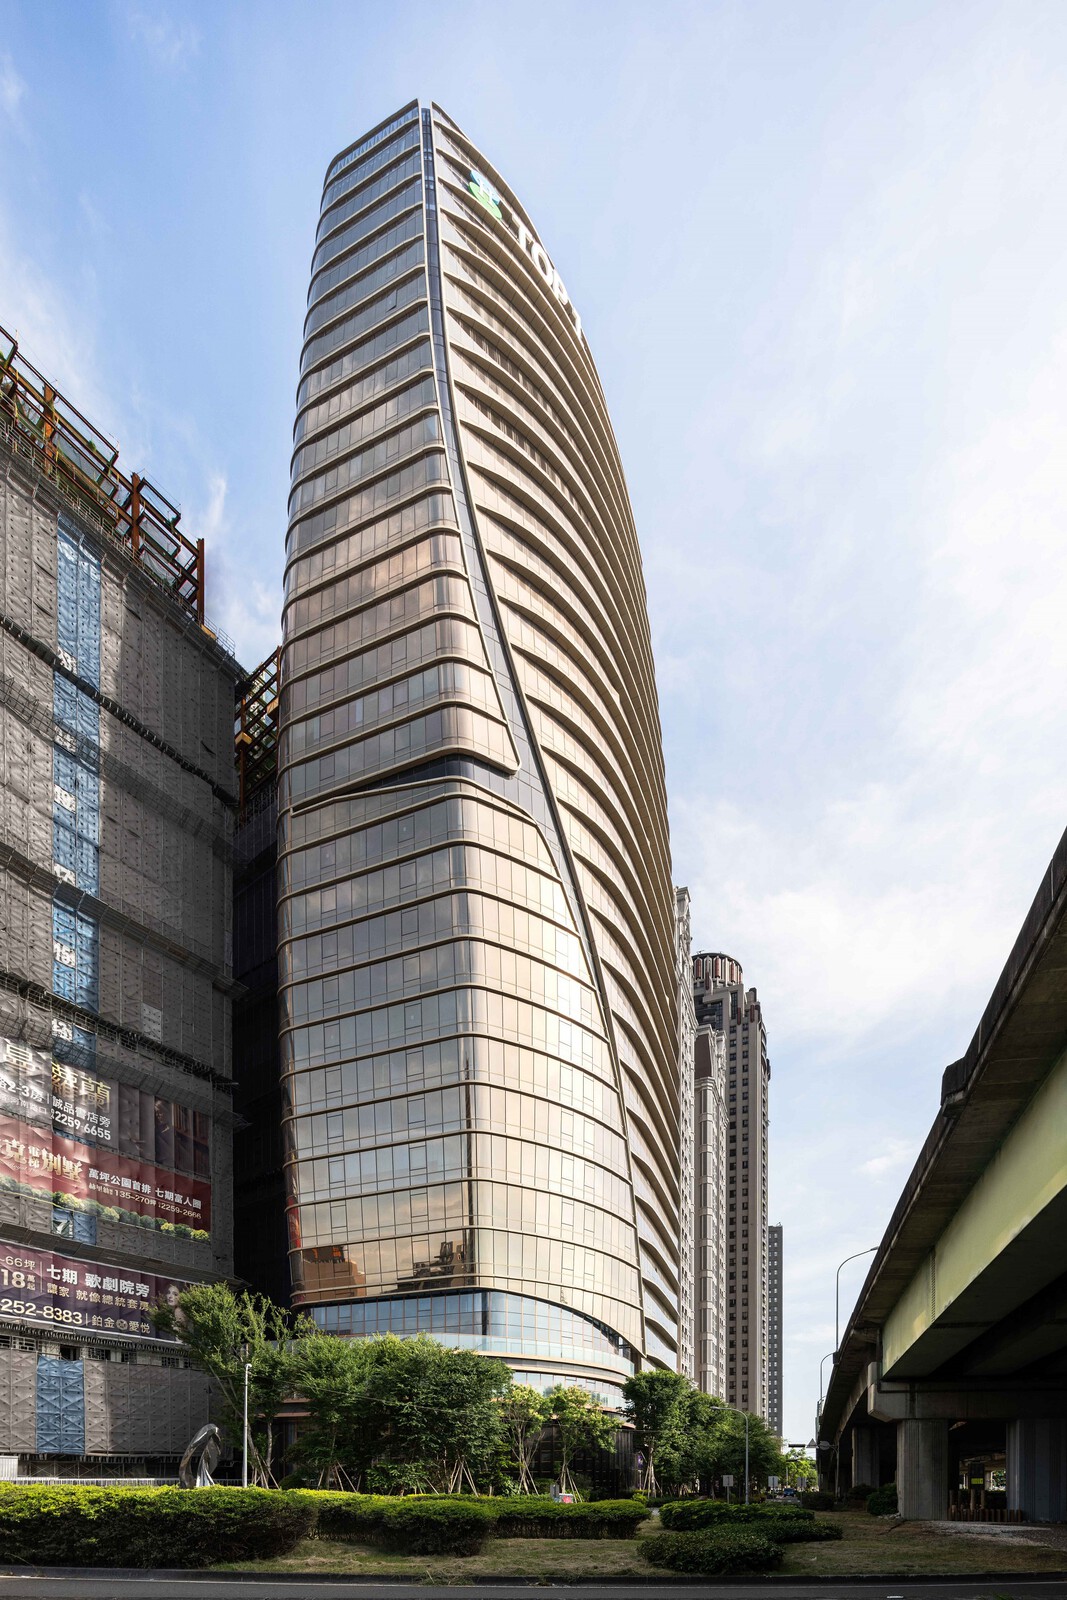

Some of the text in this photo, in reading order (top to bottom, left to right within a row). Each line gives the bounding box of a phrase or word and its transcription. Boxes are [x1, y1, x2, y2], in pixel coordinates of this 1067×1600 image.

[46, 1263, 150, 1298] 七期 歌劇院旁
